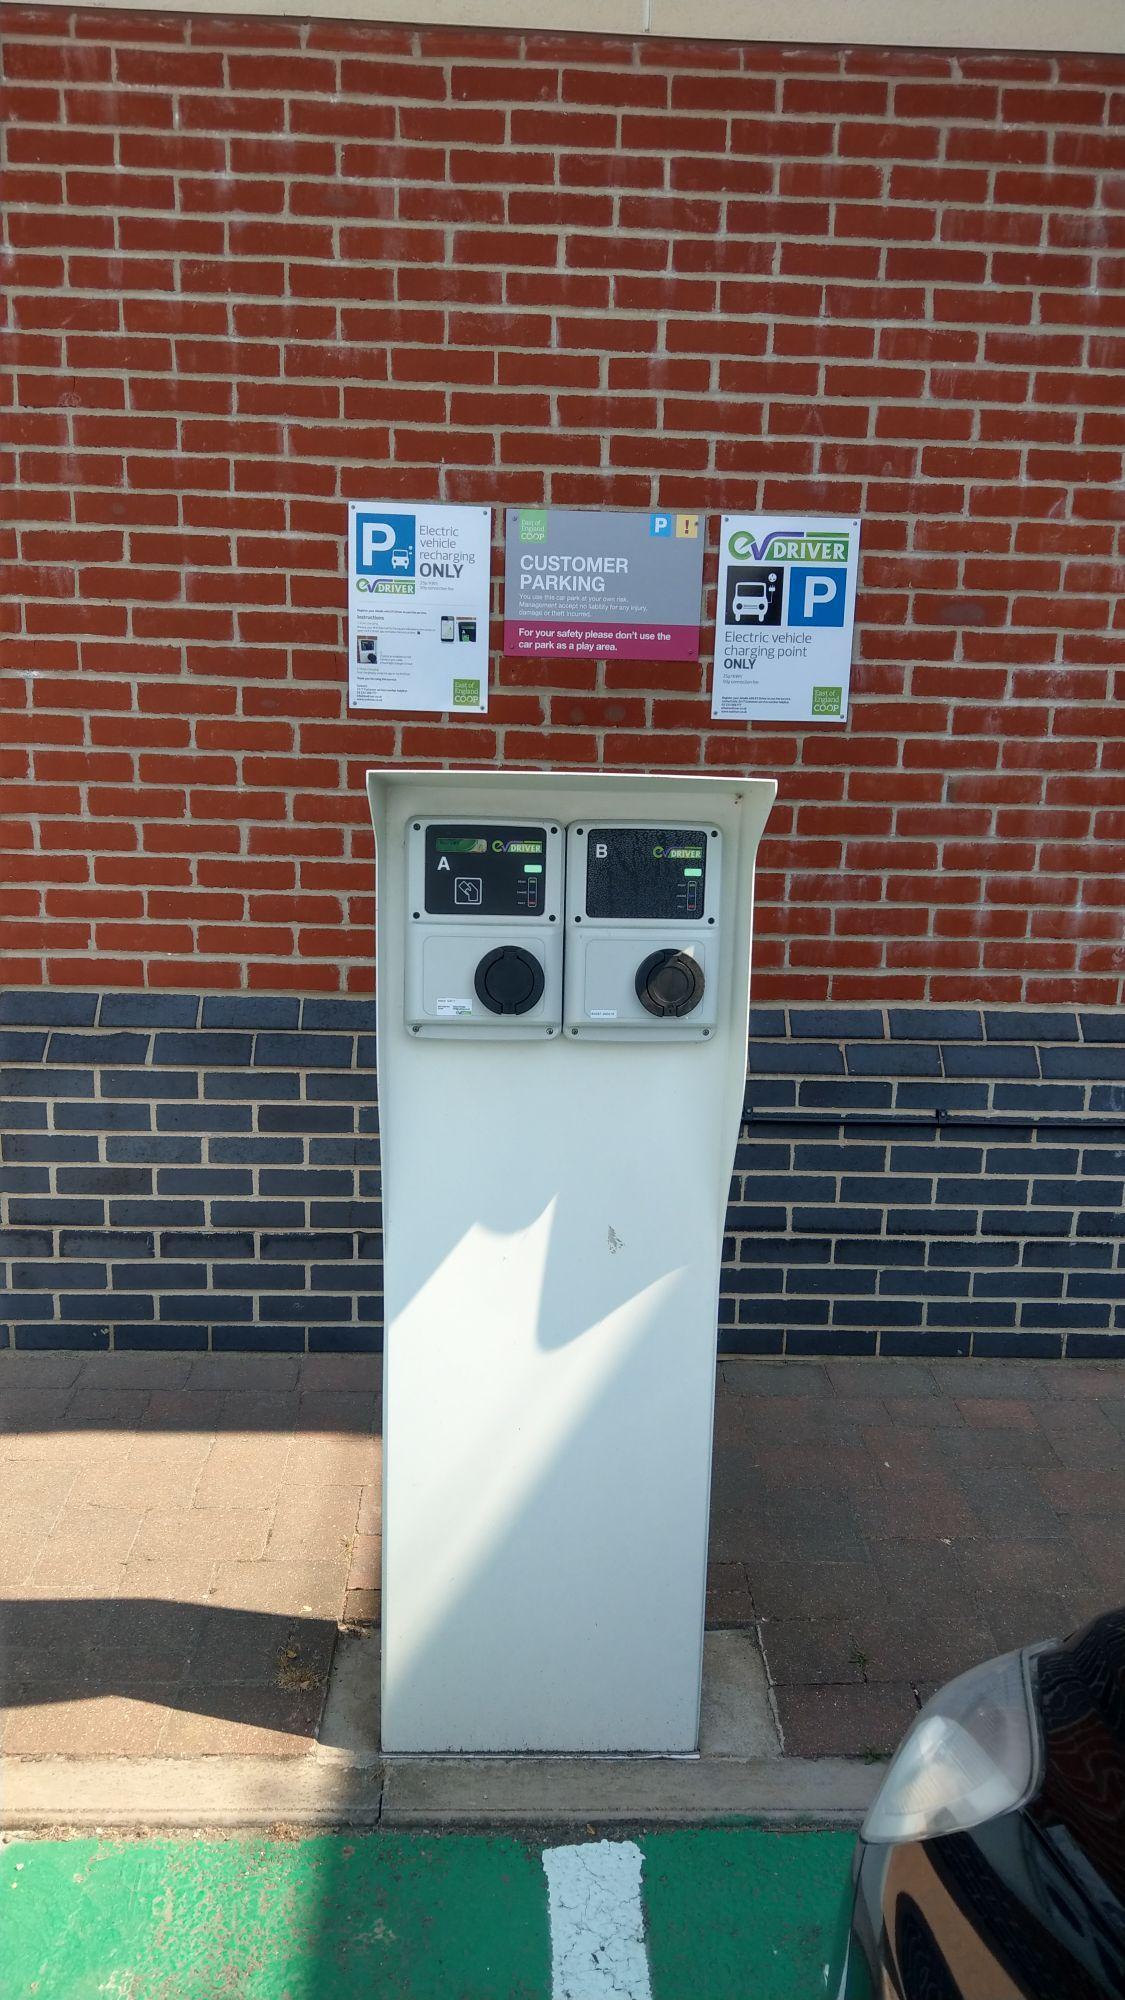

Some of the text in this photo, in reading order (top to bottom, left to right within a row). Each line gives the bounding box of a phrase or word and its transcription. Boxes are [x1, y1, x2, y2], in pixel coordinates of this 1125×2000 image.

[419, 525, 459, 537] Electric
[654, 517, 668, 533] P
[363, 522, 396, 566] P
[420, 538, 456, 548] vehicle
[419, 550, 476, 564] recharging
[772, 542, 846, 560] DRIVER
[419, 562, 464, 579] ONLY
[520, 554, 629, 574] CUSTOMER
[519, 574, 606, 593] PARKING
[803, 575, 838, 618] P
[519, 601, 558, 609] Management
[518, 628, 671, 642] For your safety please don't use the
[724, 631, 813, 644] Electric vehicle
[518, 640, 618, 652] car park as a play area.
[724, 644, 808, 660] charging point
[723, 658, 756, 670] ONLY
[454, 687, 479, 695] England
[454, 695, 479, 703] COOP
[813, 696, 840, 704] England
[813, 704, 839, 712] COOP
[510, 844, 542, 853] DRIVER
[596, 844, 608, 858] B
[671, 850, 702, 859] DRIVER
[437, 856, 451, 871] A
